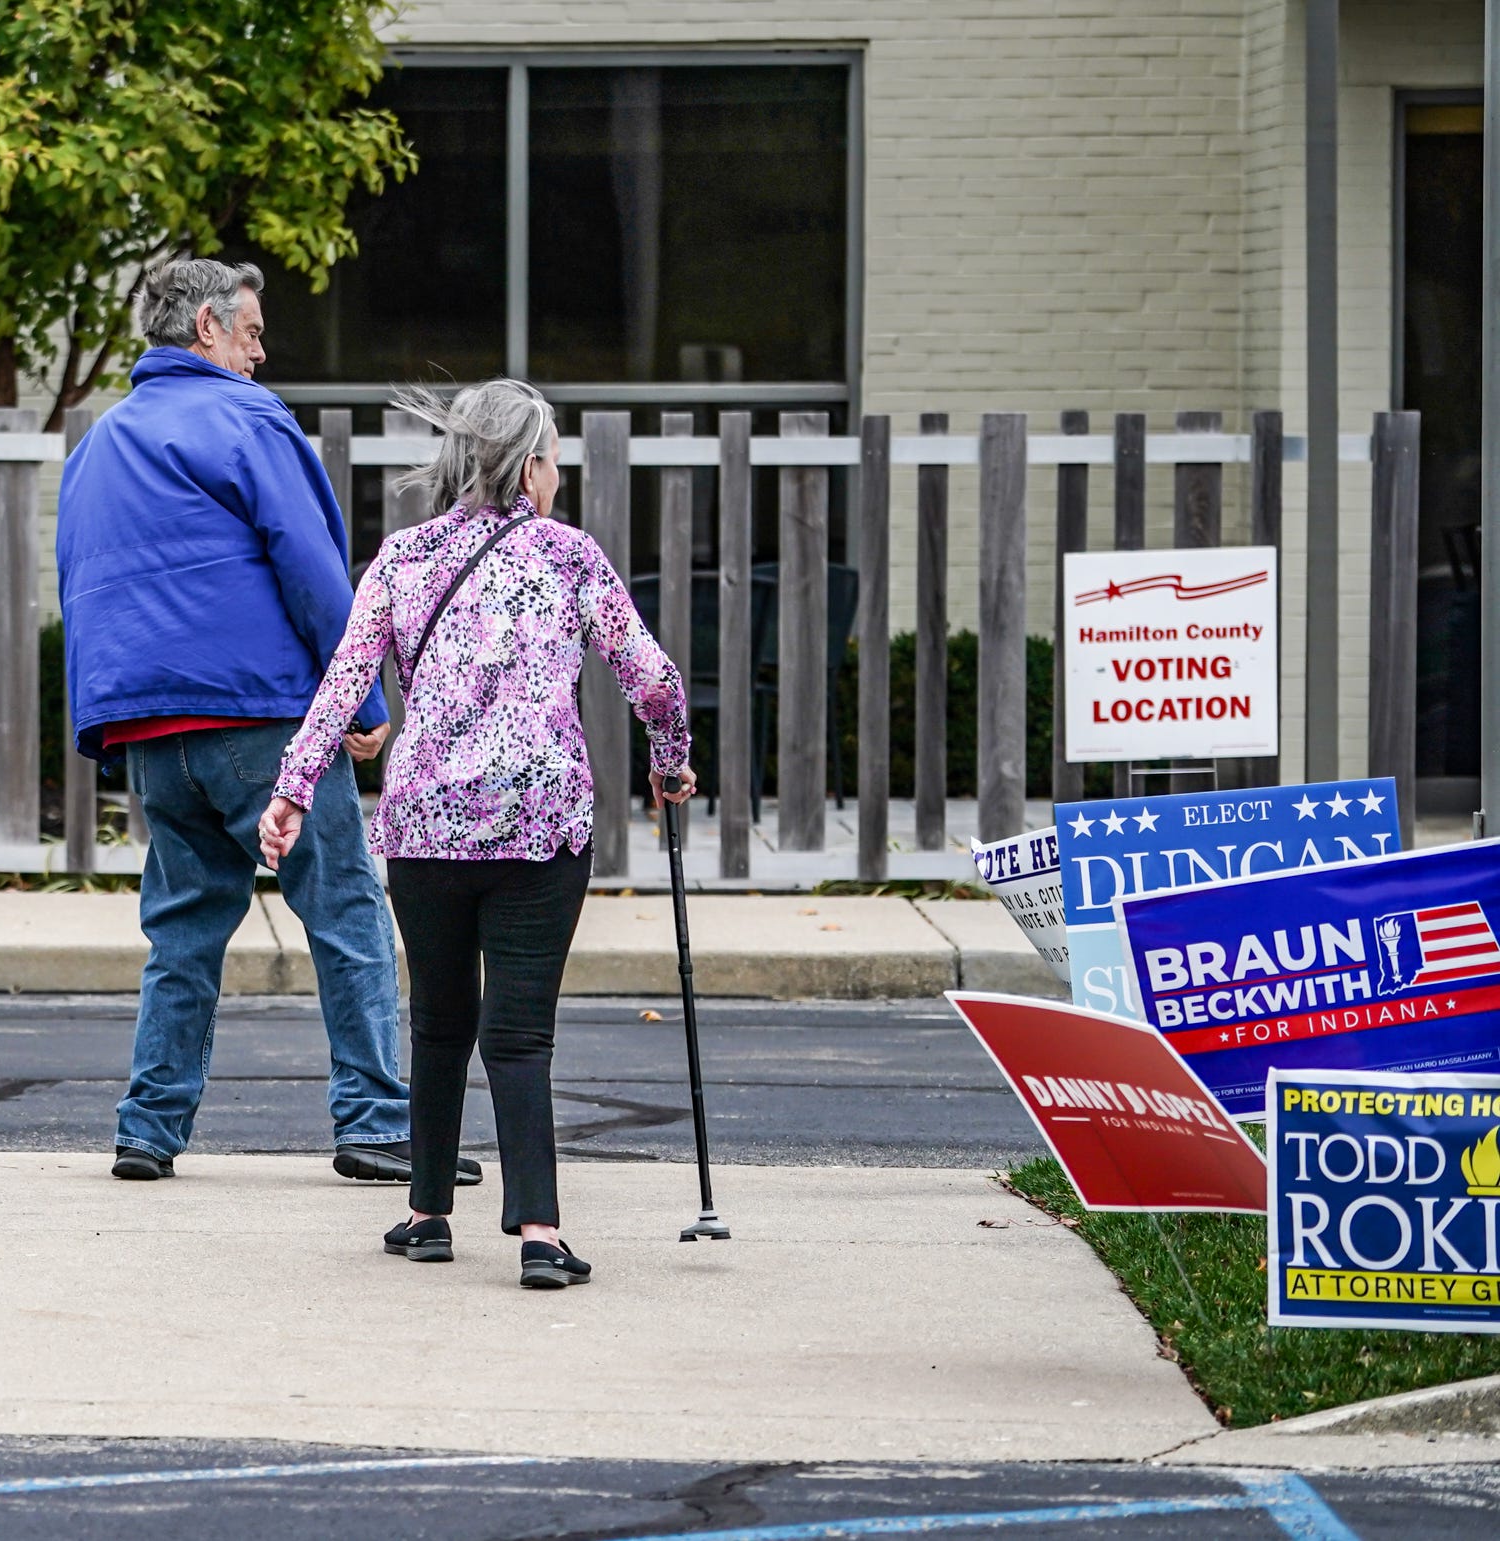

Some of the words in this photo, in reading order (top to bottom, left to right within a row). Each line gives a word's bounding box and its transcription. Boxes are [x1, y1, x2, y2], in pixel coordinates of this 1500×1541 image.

[1079, 625, 1178, 643] Hamilton
[1186, 622, 1263, 642] County
[1112, 656, 1232, 682] VOTING
[1093, 696, 1251, 723] LOCATION
[1183, 800, 1273, 827] ELECT
[975, 844, 1021, 880] OTE
[1014, 892, 1037, 909] U.S.
[1039, 884, 1063, 905] CITI
[1144, 918, 1367, 993] BRAUN
[1154, 970, 1373, 1028] BECKWITH
[1235, 1021, 1290, 1044] FOR
[1309, 1000, 1439, 1034] INDIANA
[1414, 1060, 1438, 1070] MARIO
[1022, 1075, 1126, 1112] DANNY
[1137, 1087, 1229, 1132] LOPEZ
[1284, 1089, 1465, 1117] PROTECTING
[1101, 1116, 1129, 1128] FOR
[1134, 1119, 1195, 1137] INDIANA
[1285, 1132, 1447, 1185] TODD
[1291, 1274, 1457, 1301] ATTORNEY
